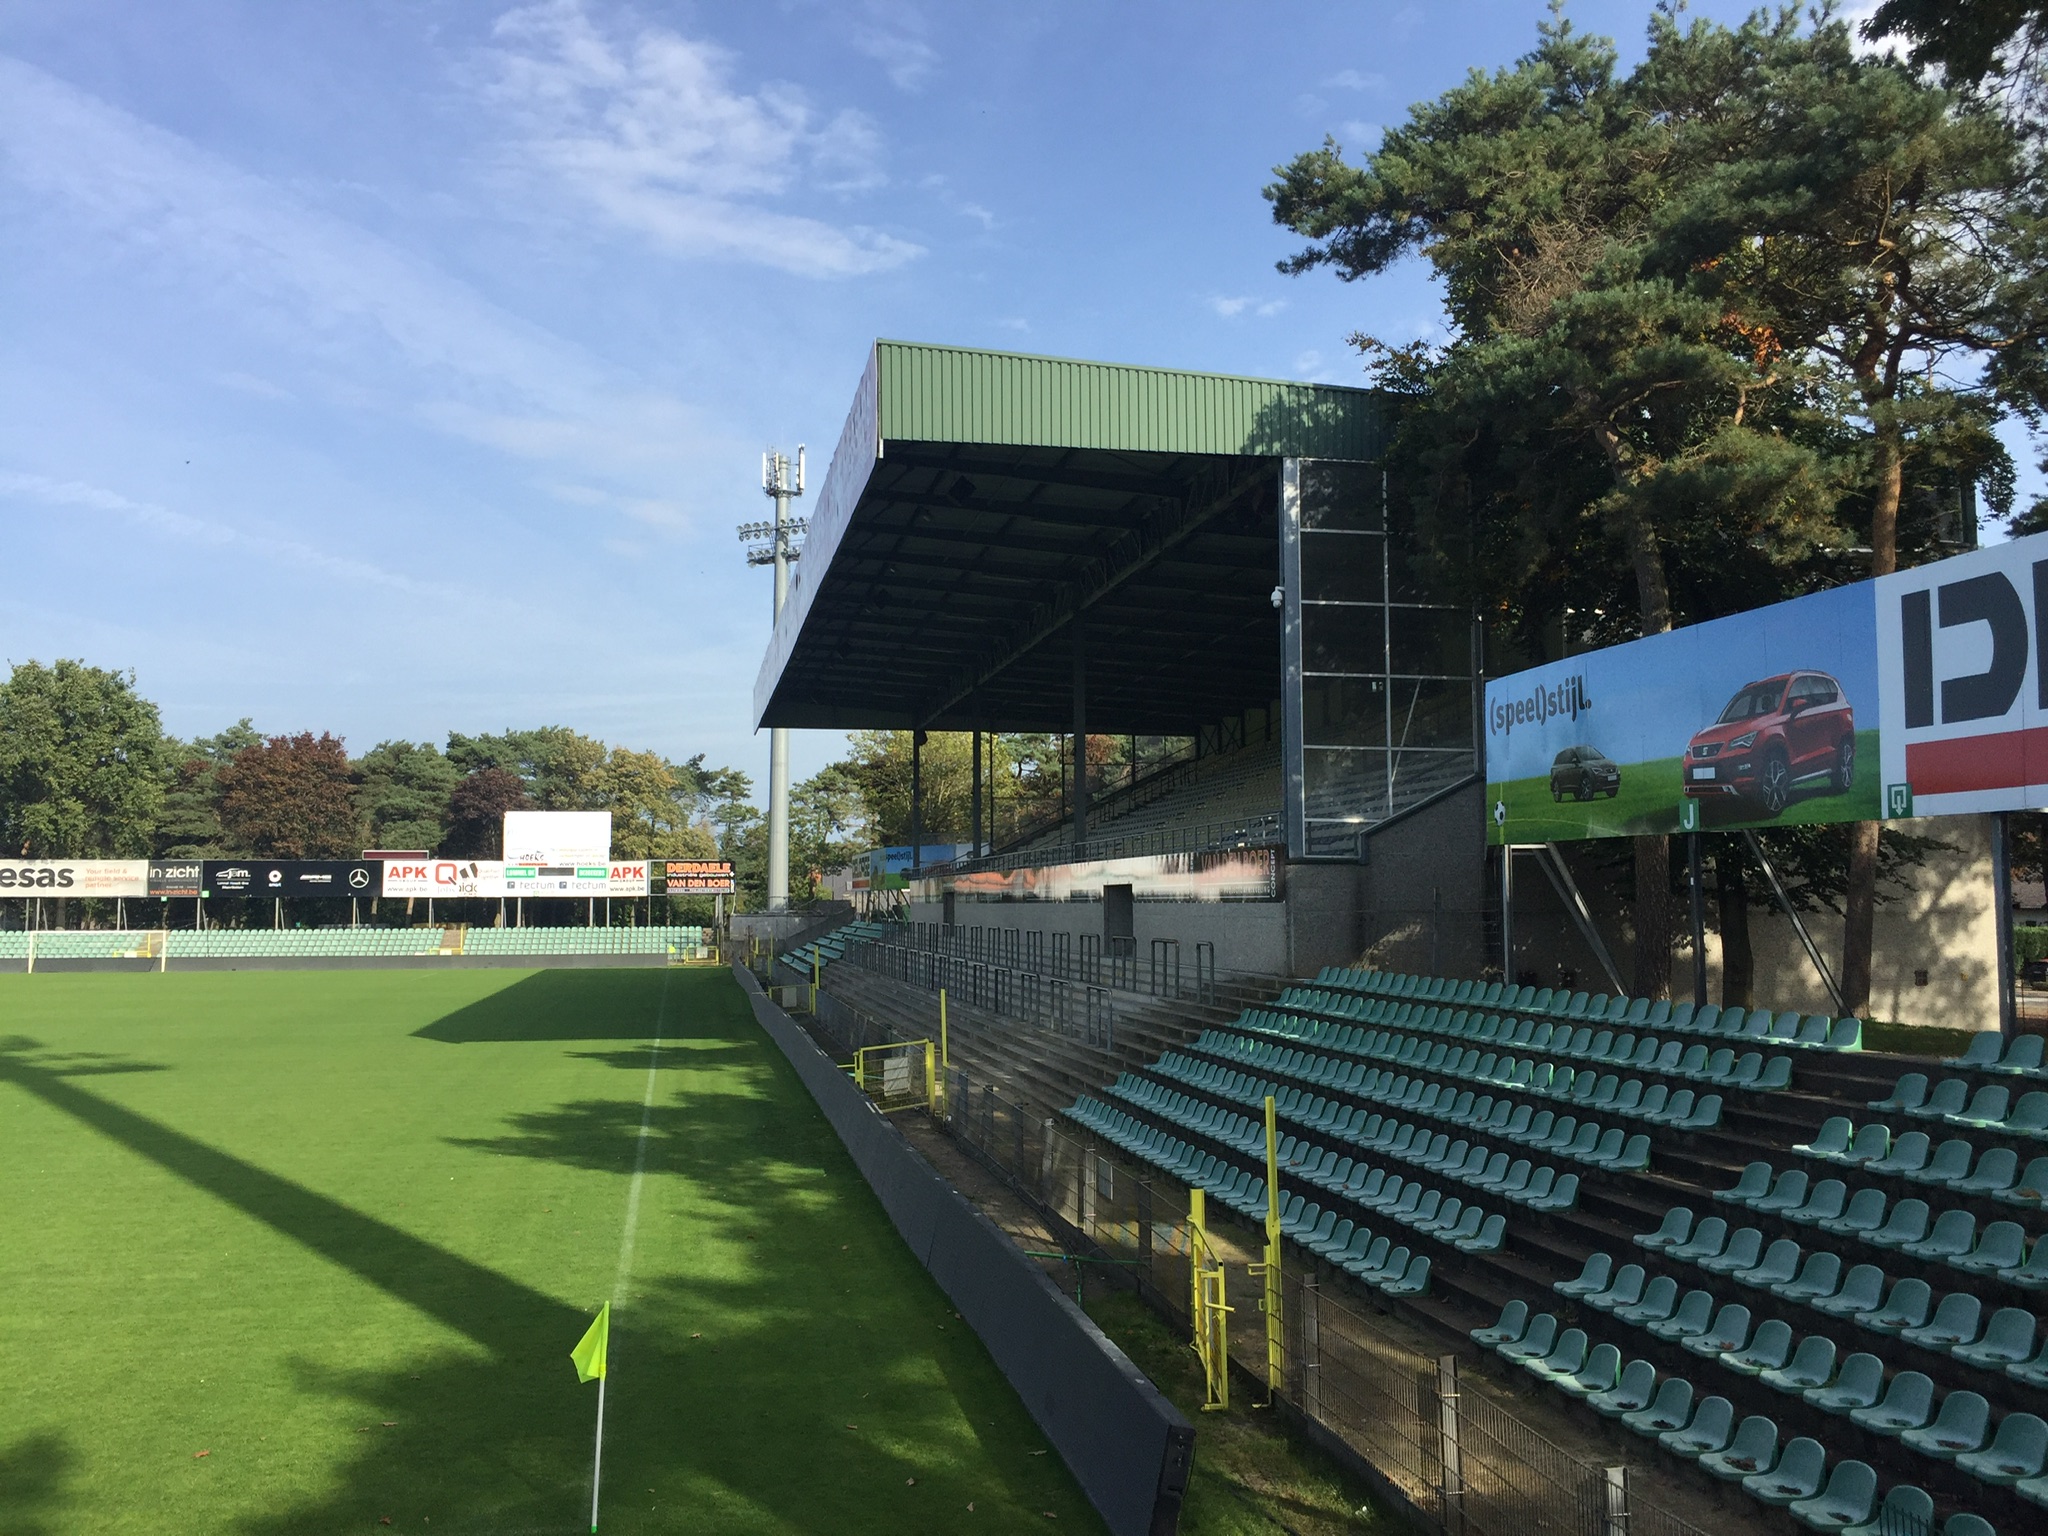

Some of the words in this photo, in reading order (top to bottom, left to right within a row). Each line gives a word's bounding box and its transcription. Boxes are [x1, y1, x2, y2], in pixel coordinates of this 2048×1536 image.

[1490, 675, 1592, 736] (speel)stijl.
[1683, 803, 1694, 830] J
[666, 862, 731, 873] DERDAELE
[1243, 849, 1270, 875] BOER
[86, 867, 102, 875] Your
[104, 867, 121, 875] field
[388, 866, 428, 879] APK
[610, 866, 645, 879] APK
[519, 881, 555, 890] tectum
[571, 881, 607, 890] tectum
[667, 879, 687, 888] VAN
[688, 879, 706, 888] DEN
[707, 879, 731, 888] BOER
